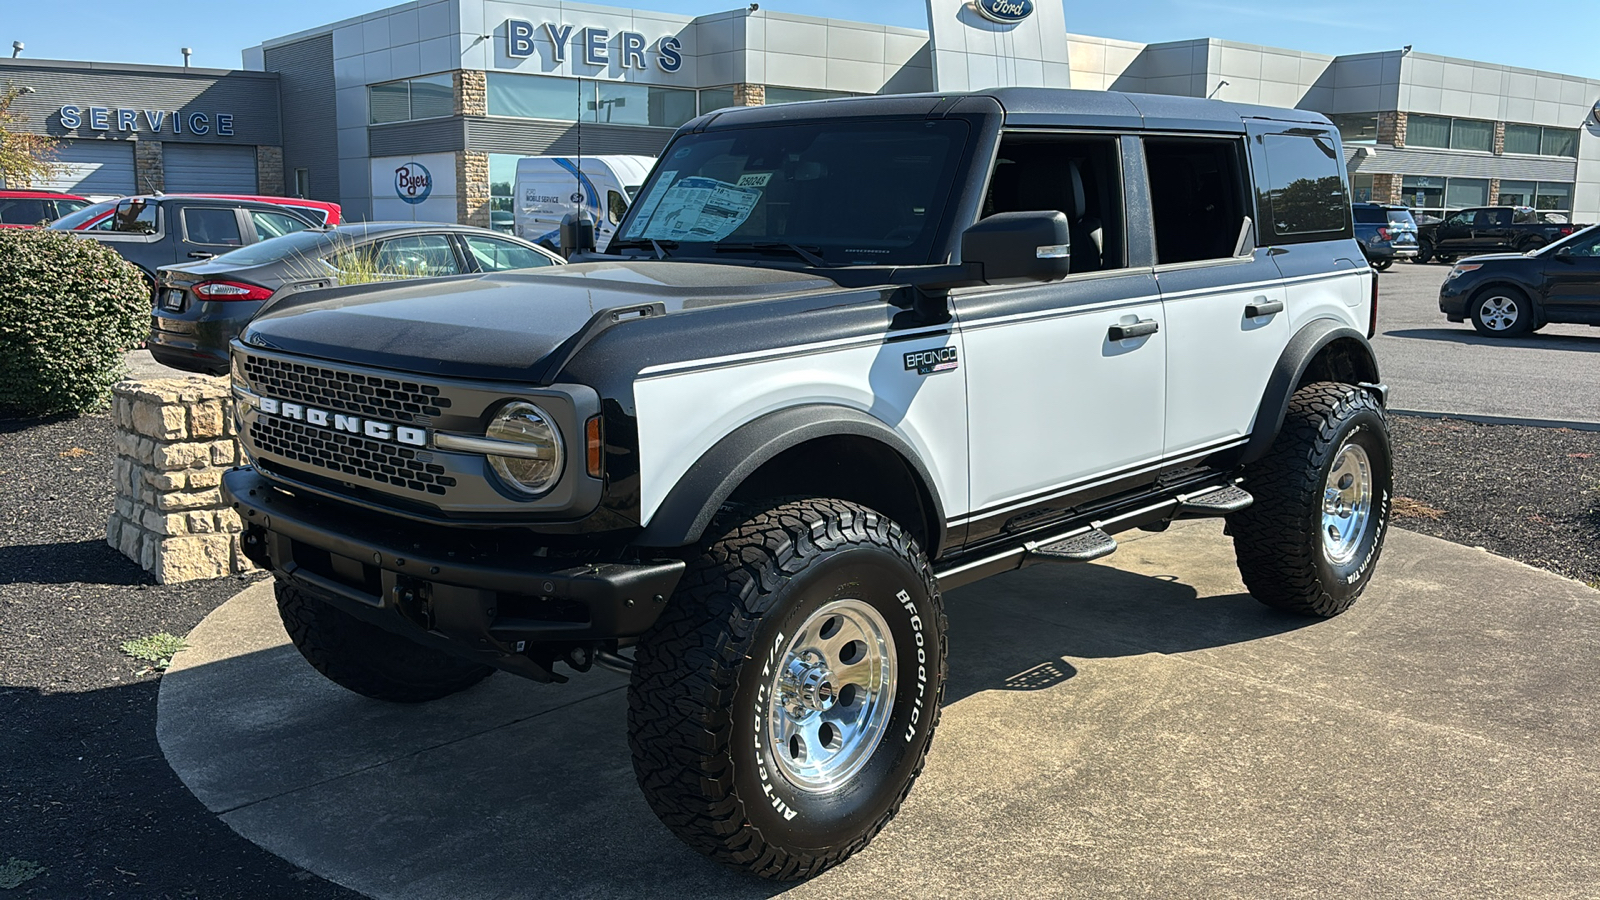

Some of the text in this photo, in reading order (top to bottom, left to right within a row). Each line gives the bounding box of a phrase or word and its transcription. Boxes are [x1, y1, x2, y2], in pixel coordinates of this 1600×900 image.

[507, 18, 683, 73] BYERS
[60, 104, 235, 136] SERVICE
[395, 166, 431, 196] Byers
[739, 176, 766, 186] 250248
[906, 347, 957, 367] BRONCO
[260, 397, 427, 447] BRONCO
[895, 588, 928, 743] BFGoodrich
